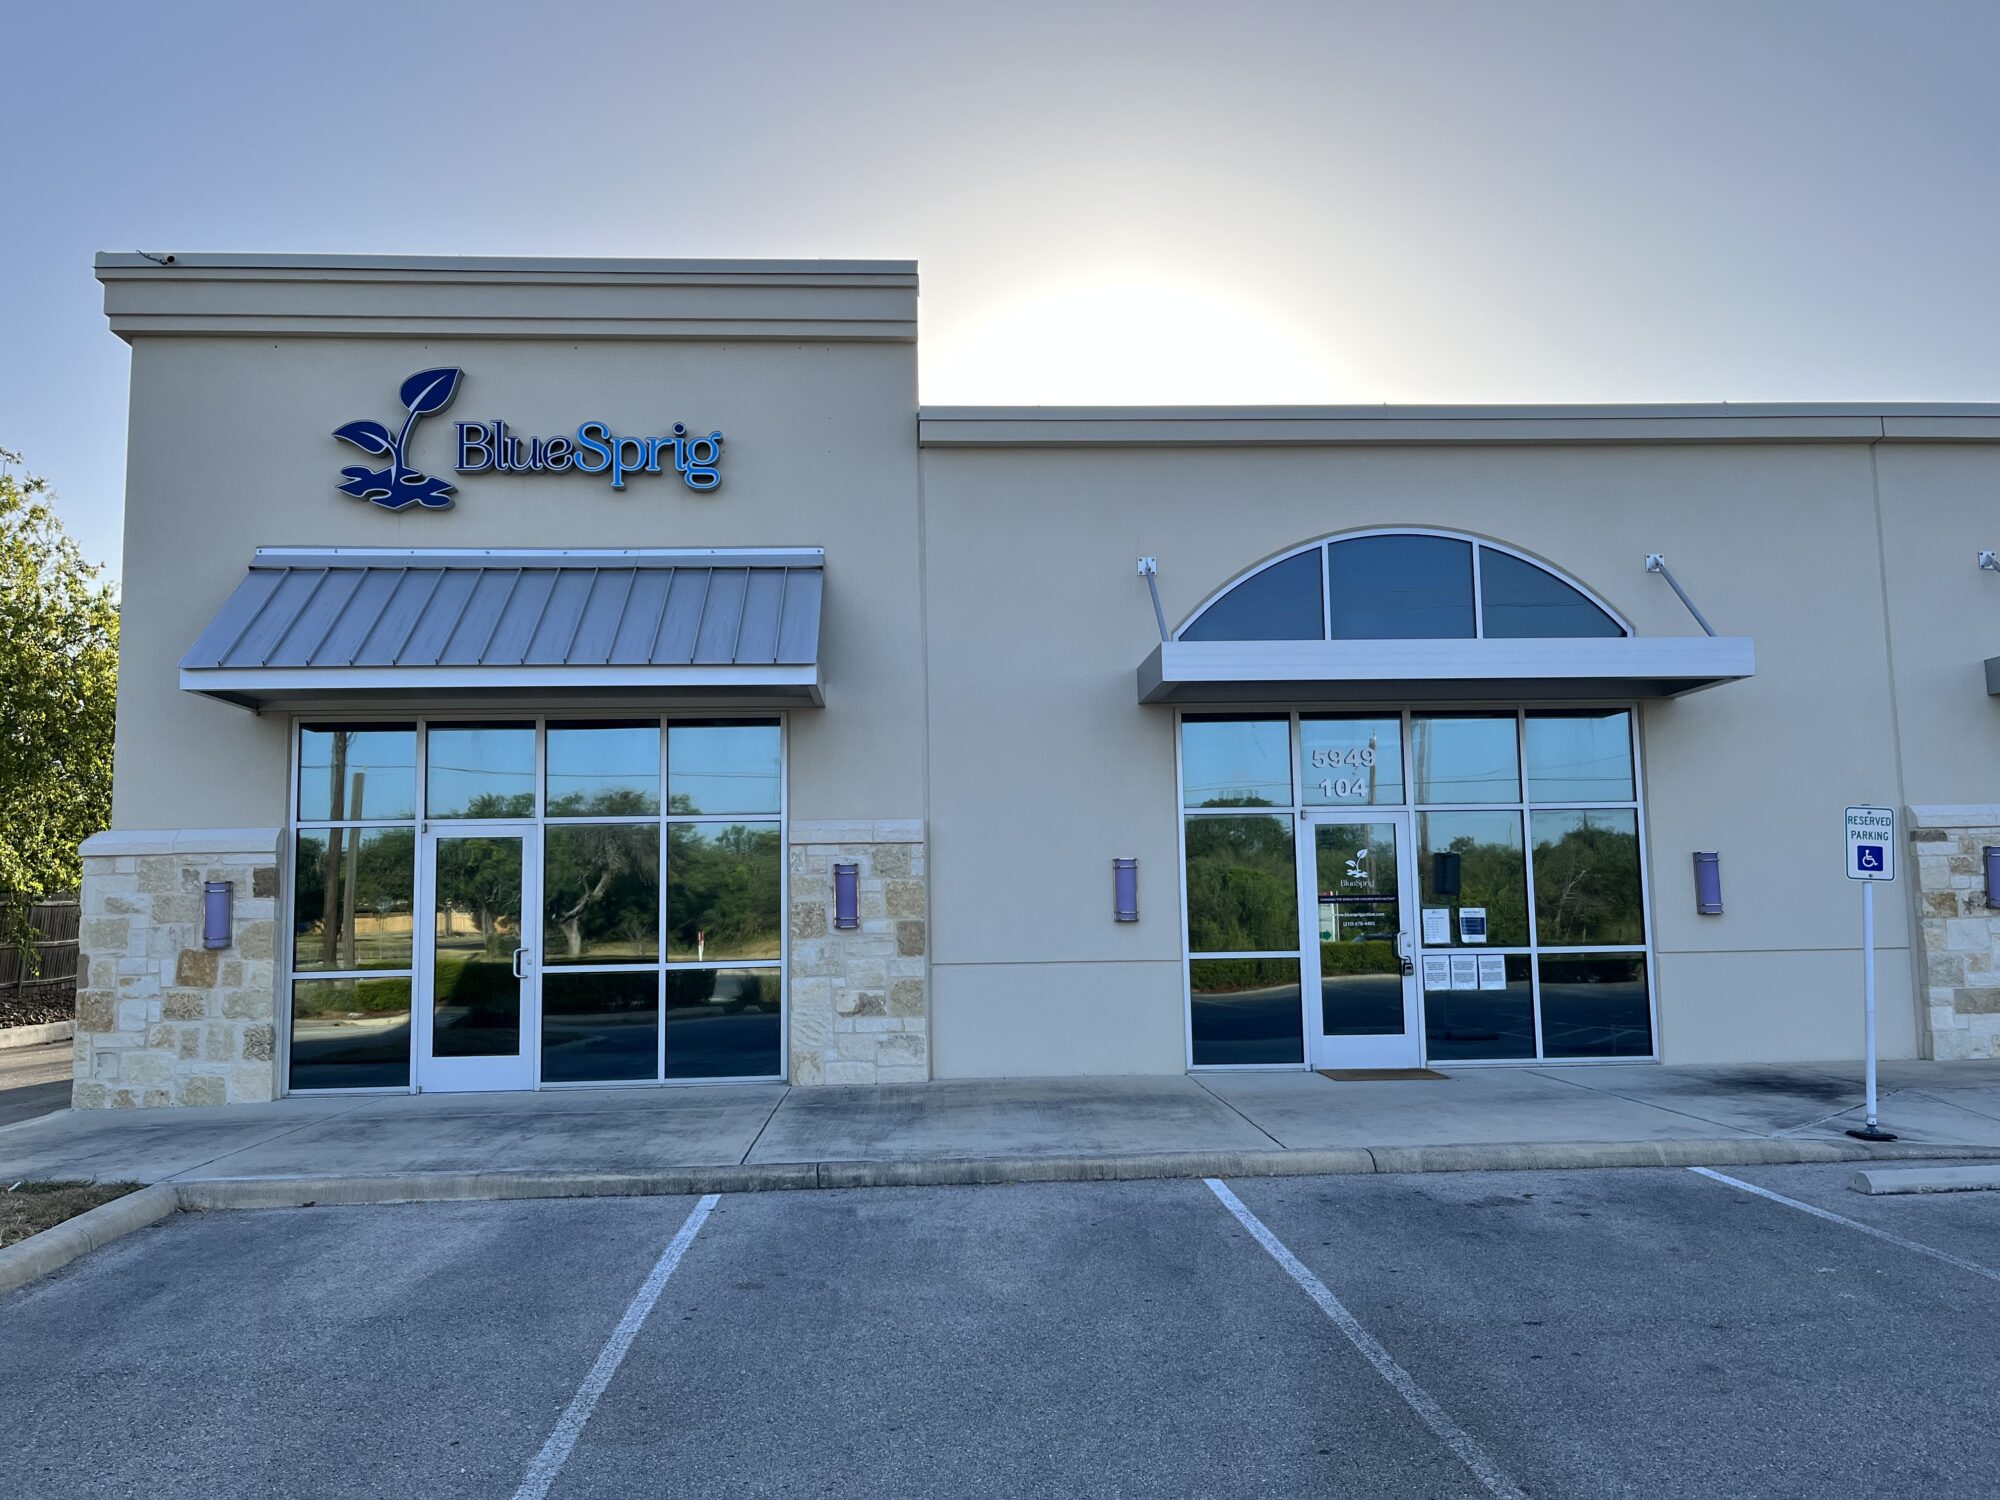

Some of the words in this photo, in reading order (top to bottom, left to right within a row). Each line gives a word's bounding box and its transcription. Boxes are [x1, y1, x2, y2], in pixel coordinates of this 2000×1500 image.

[454, 420, 723, 492] BlueSprig
[1312, 747, 1375, 768] 5949
[1319, 778, 1366, 797] 104
[1848, 816, 1891, 826] RESERVED
[1851, 831, 1888, 841] PARKING
[1340, 879, 1375, 889] BlueSprig
